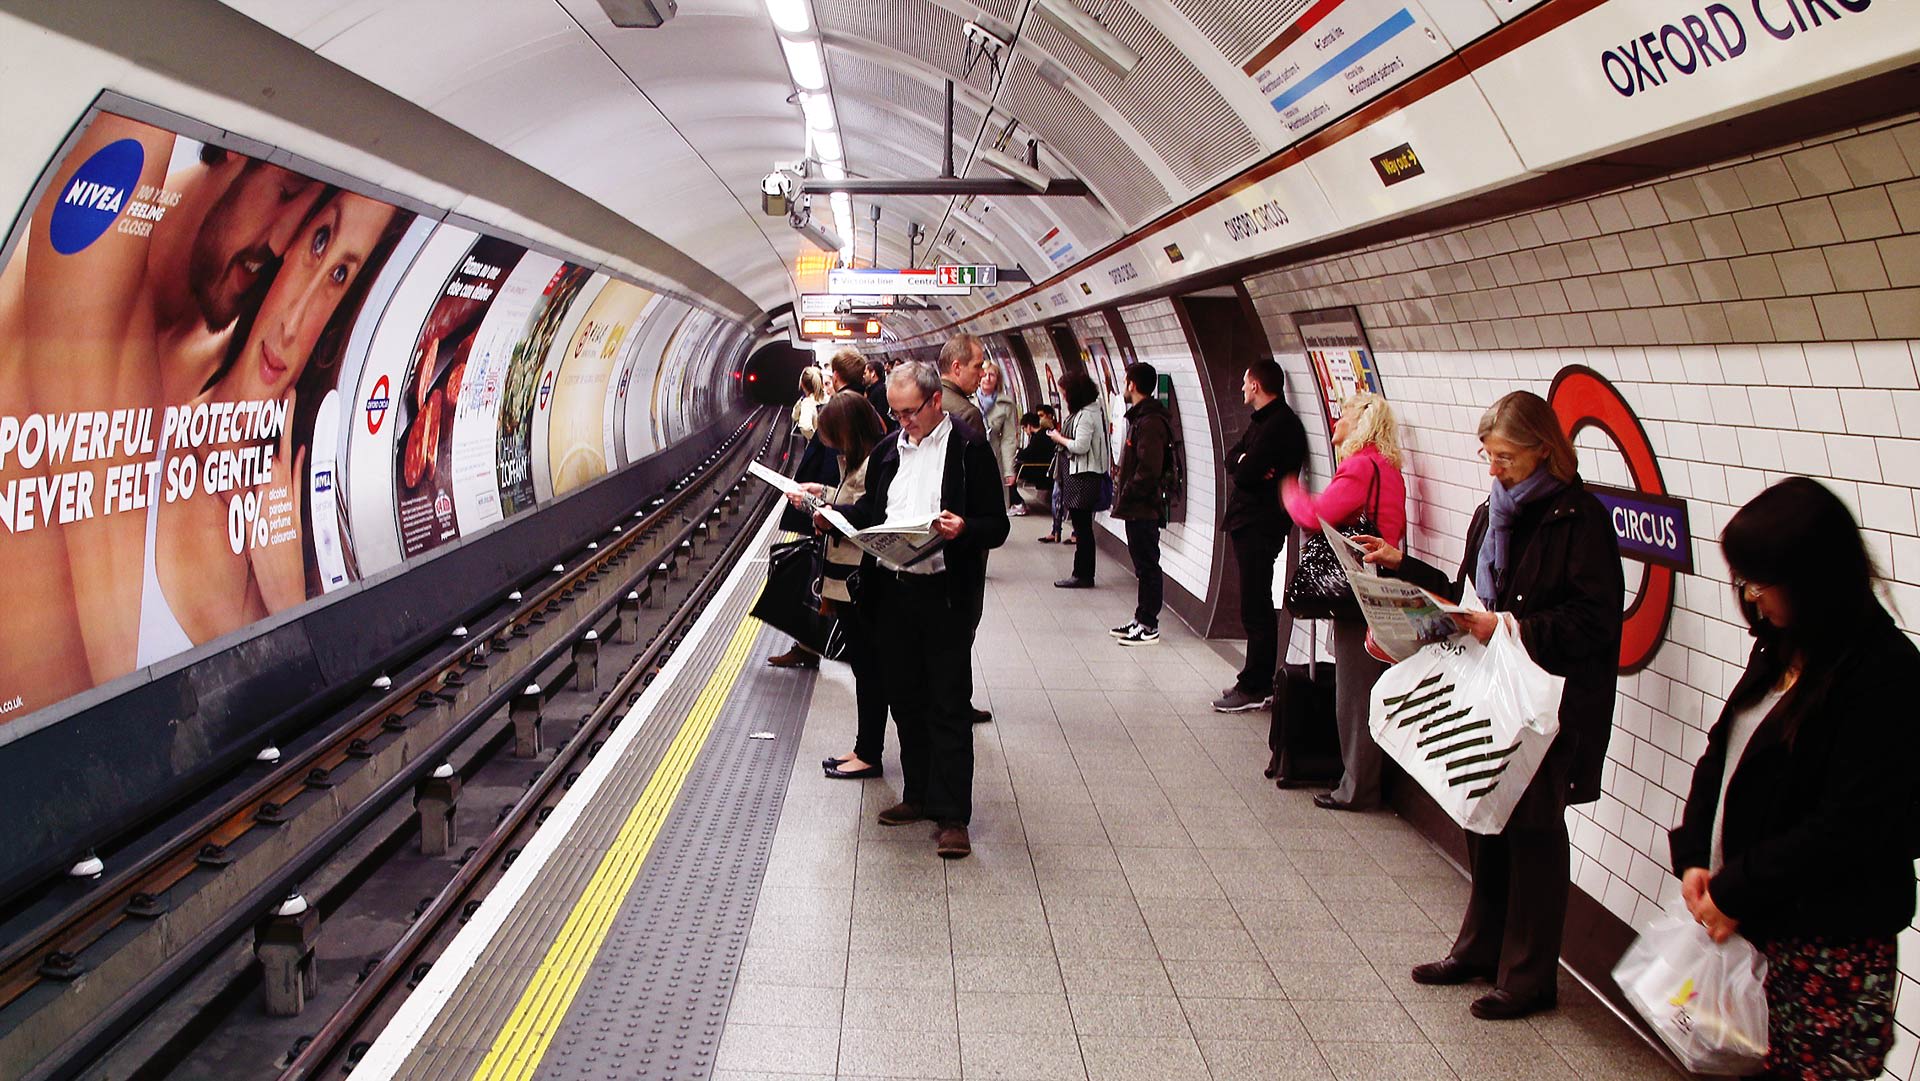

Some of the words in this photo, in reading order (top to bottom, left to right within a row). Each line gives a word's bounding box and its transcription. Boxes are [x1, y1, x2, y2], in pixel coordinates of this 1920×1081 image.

[1601, 3, 1747, 97] OXFORD
[1753, 0, 1872, 41] CIR
[1380, 158, 1400, 176] Way
[1396, 153, 1411, 170] out
[64, 178, 124, 213] NIVEA
[152, 188, 182, 207] YEARS
[126, 201, 166, 221] FEELING
[1224, 212, 1258, 241] OXFORD
[1252, 200, 1289, 231] CIRCUS
[117, 218, 153, 237] CLOSER
[908, 277, 937, 285] Centra
[0, 407, 153, 471] POWERFUL
[161, 399, 289, 450] PROTECTION
[500, 455, 527, 488] ZOFFANY
[0, 471, 94, 535] NEVER
[103, 460, 161, 516] FELT
[165, 454, 197, 503] SO
[202, 444, 274, 495] GENTLE
[268, 486, 287, 500] alcohol
[269, 501, 292, 517] parabens
[228, 490, 268, 555] 0%
[270, 516, 291, 532] perfume
[1612, 506, 1677, 550] CIRCUS
[271, 528, 296, 544] colourants
